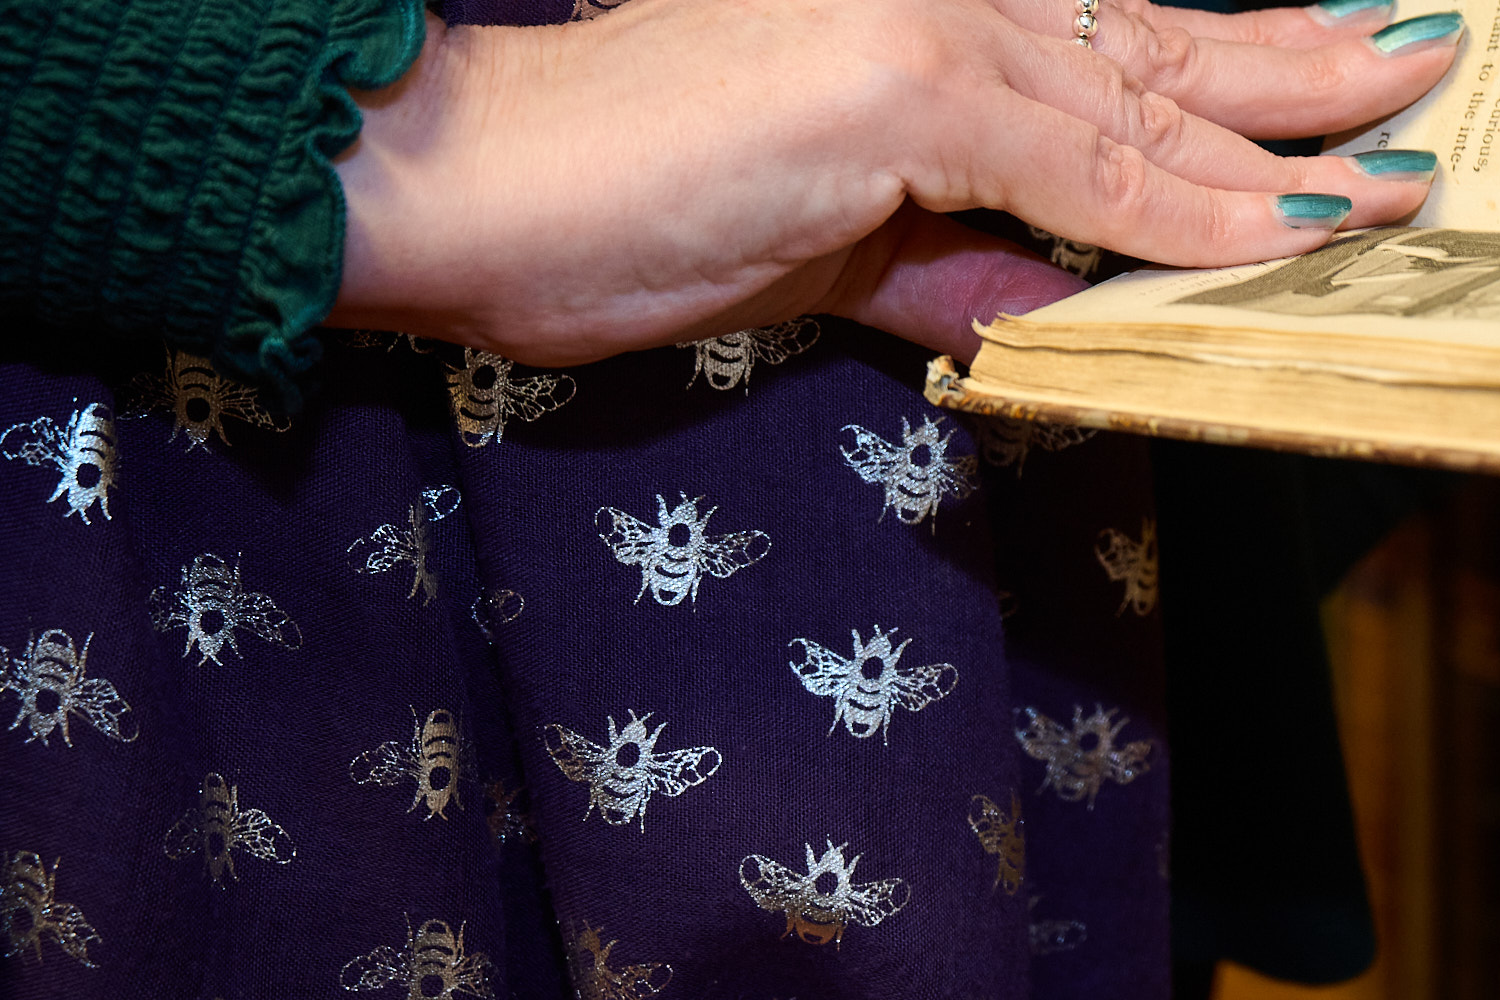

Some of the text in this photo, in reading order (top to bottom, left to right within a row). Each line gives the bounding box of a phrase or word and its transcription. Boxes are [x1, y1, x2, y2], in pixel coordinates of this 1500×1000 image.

[1478, 64, 1494, 81] to
[1465, 92, 1485, 120] the
[1450, 126, 1474, 172] inte-
